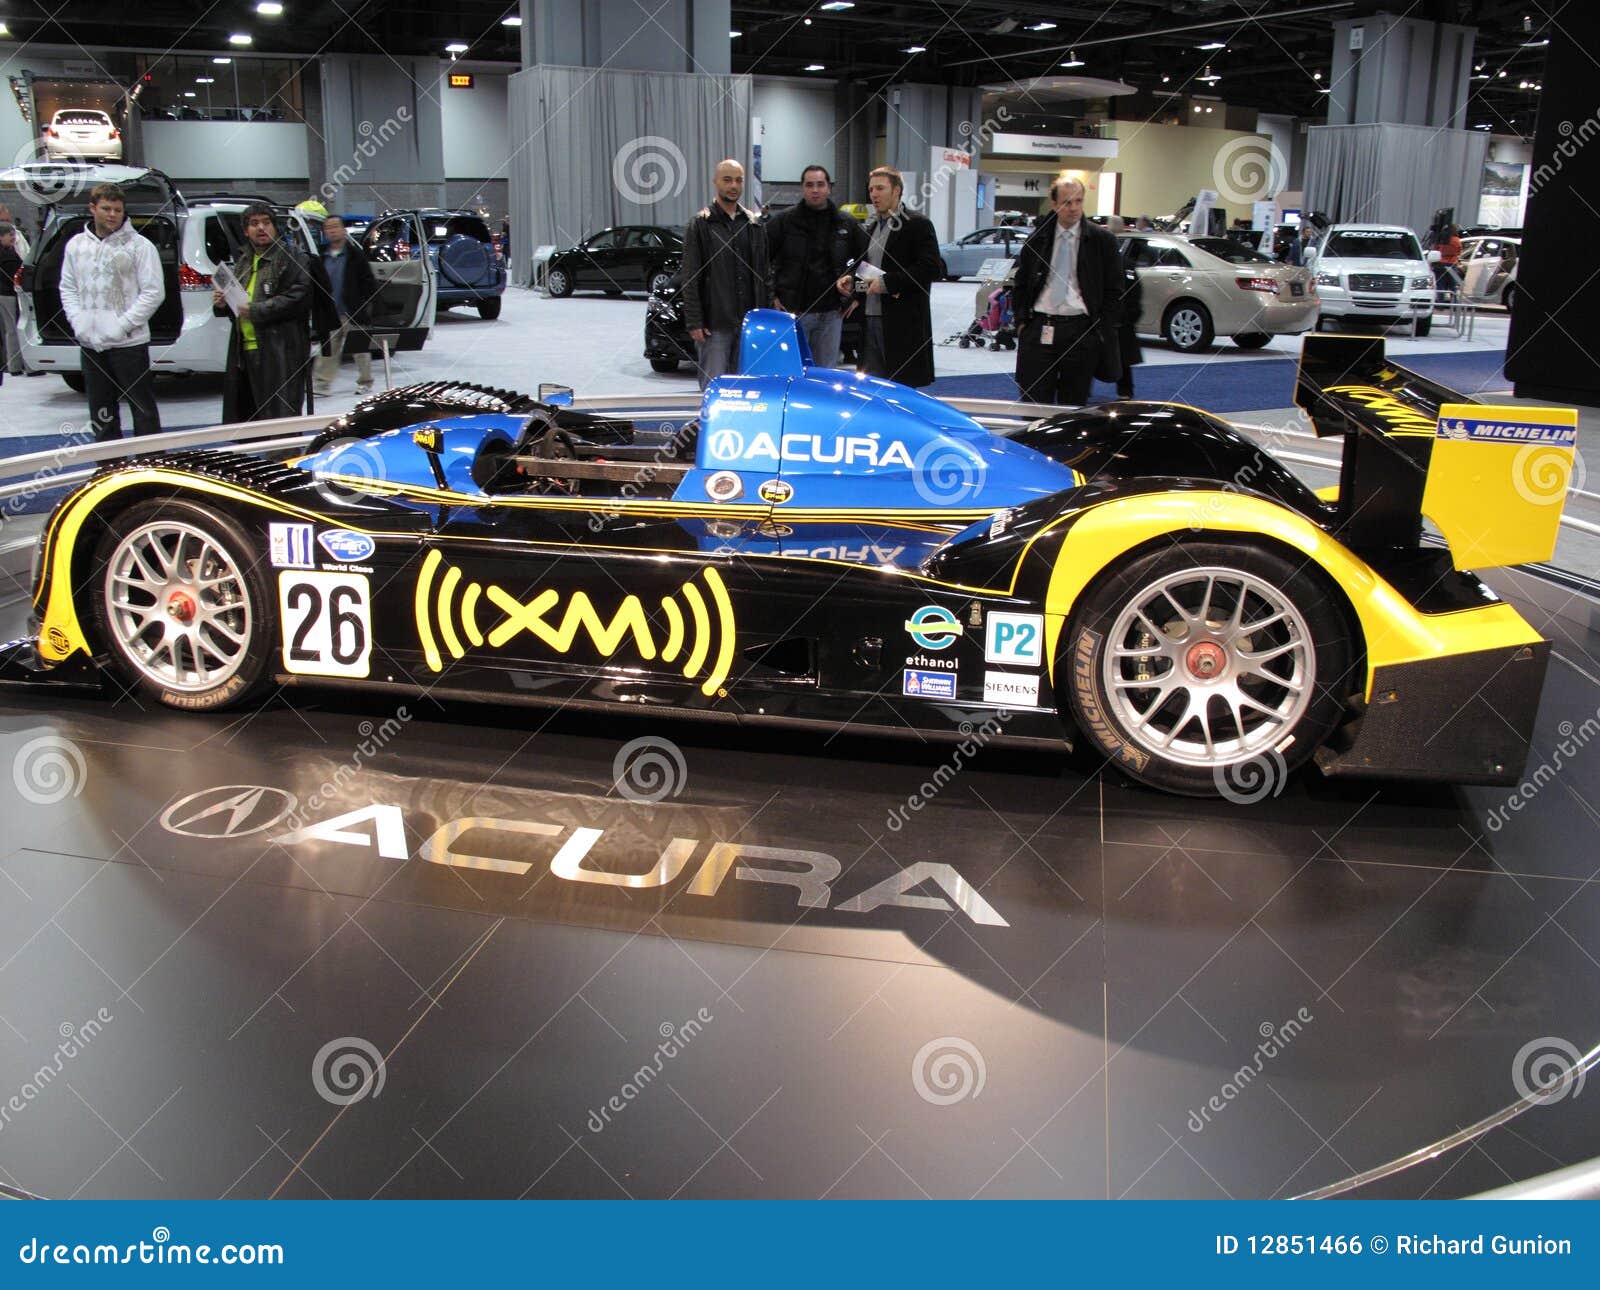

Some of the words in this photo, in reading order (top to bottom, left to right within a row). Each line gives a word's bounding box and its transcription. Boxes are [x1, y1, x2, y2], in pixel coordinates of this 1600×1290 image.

[743, 432, 915, 469] ACURA
[1473, 424, 1576, 442] MICHELIN
[287, 583, 364, 666] 26
[994, 622, 1036, 656] P2
[905, 655, 959, 669] ethanol
[985, 682, 1038, 695] SIEMENS
[1076, 631, 1123, 751] MICHELIN
[266, 803, 1011, 927] ACURA
